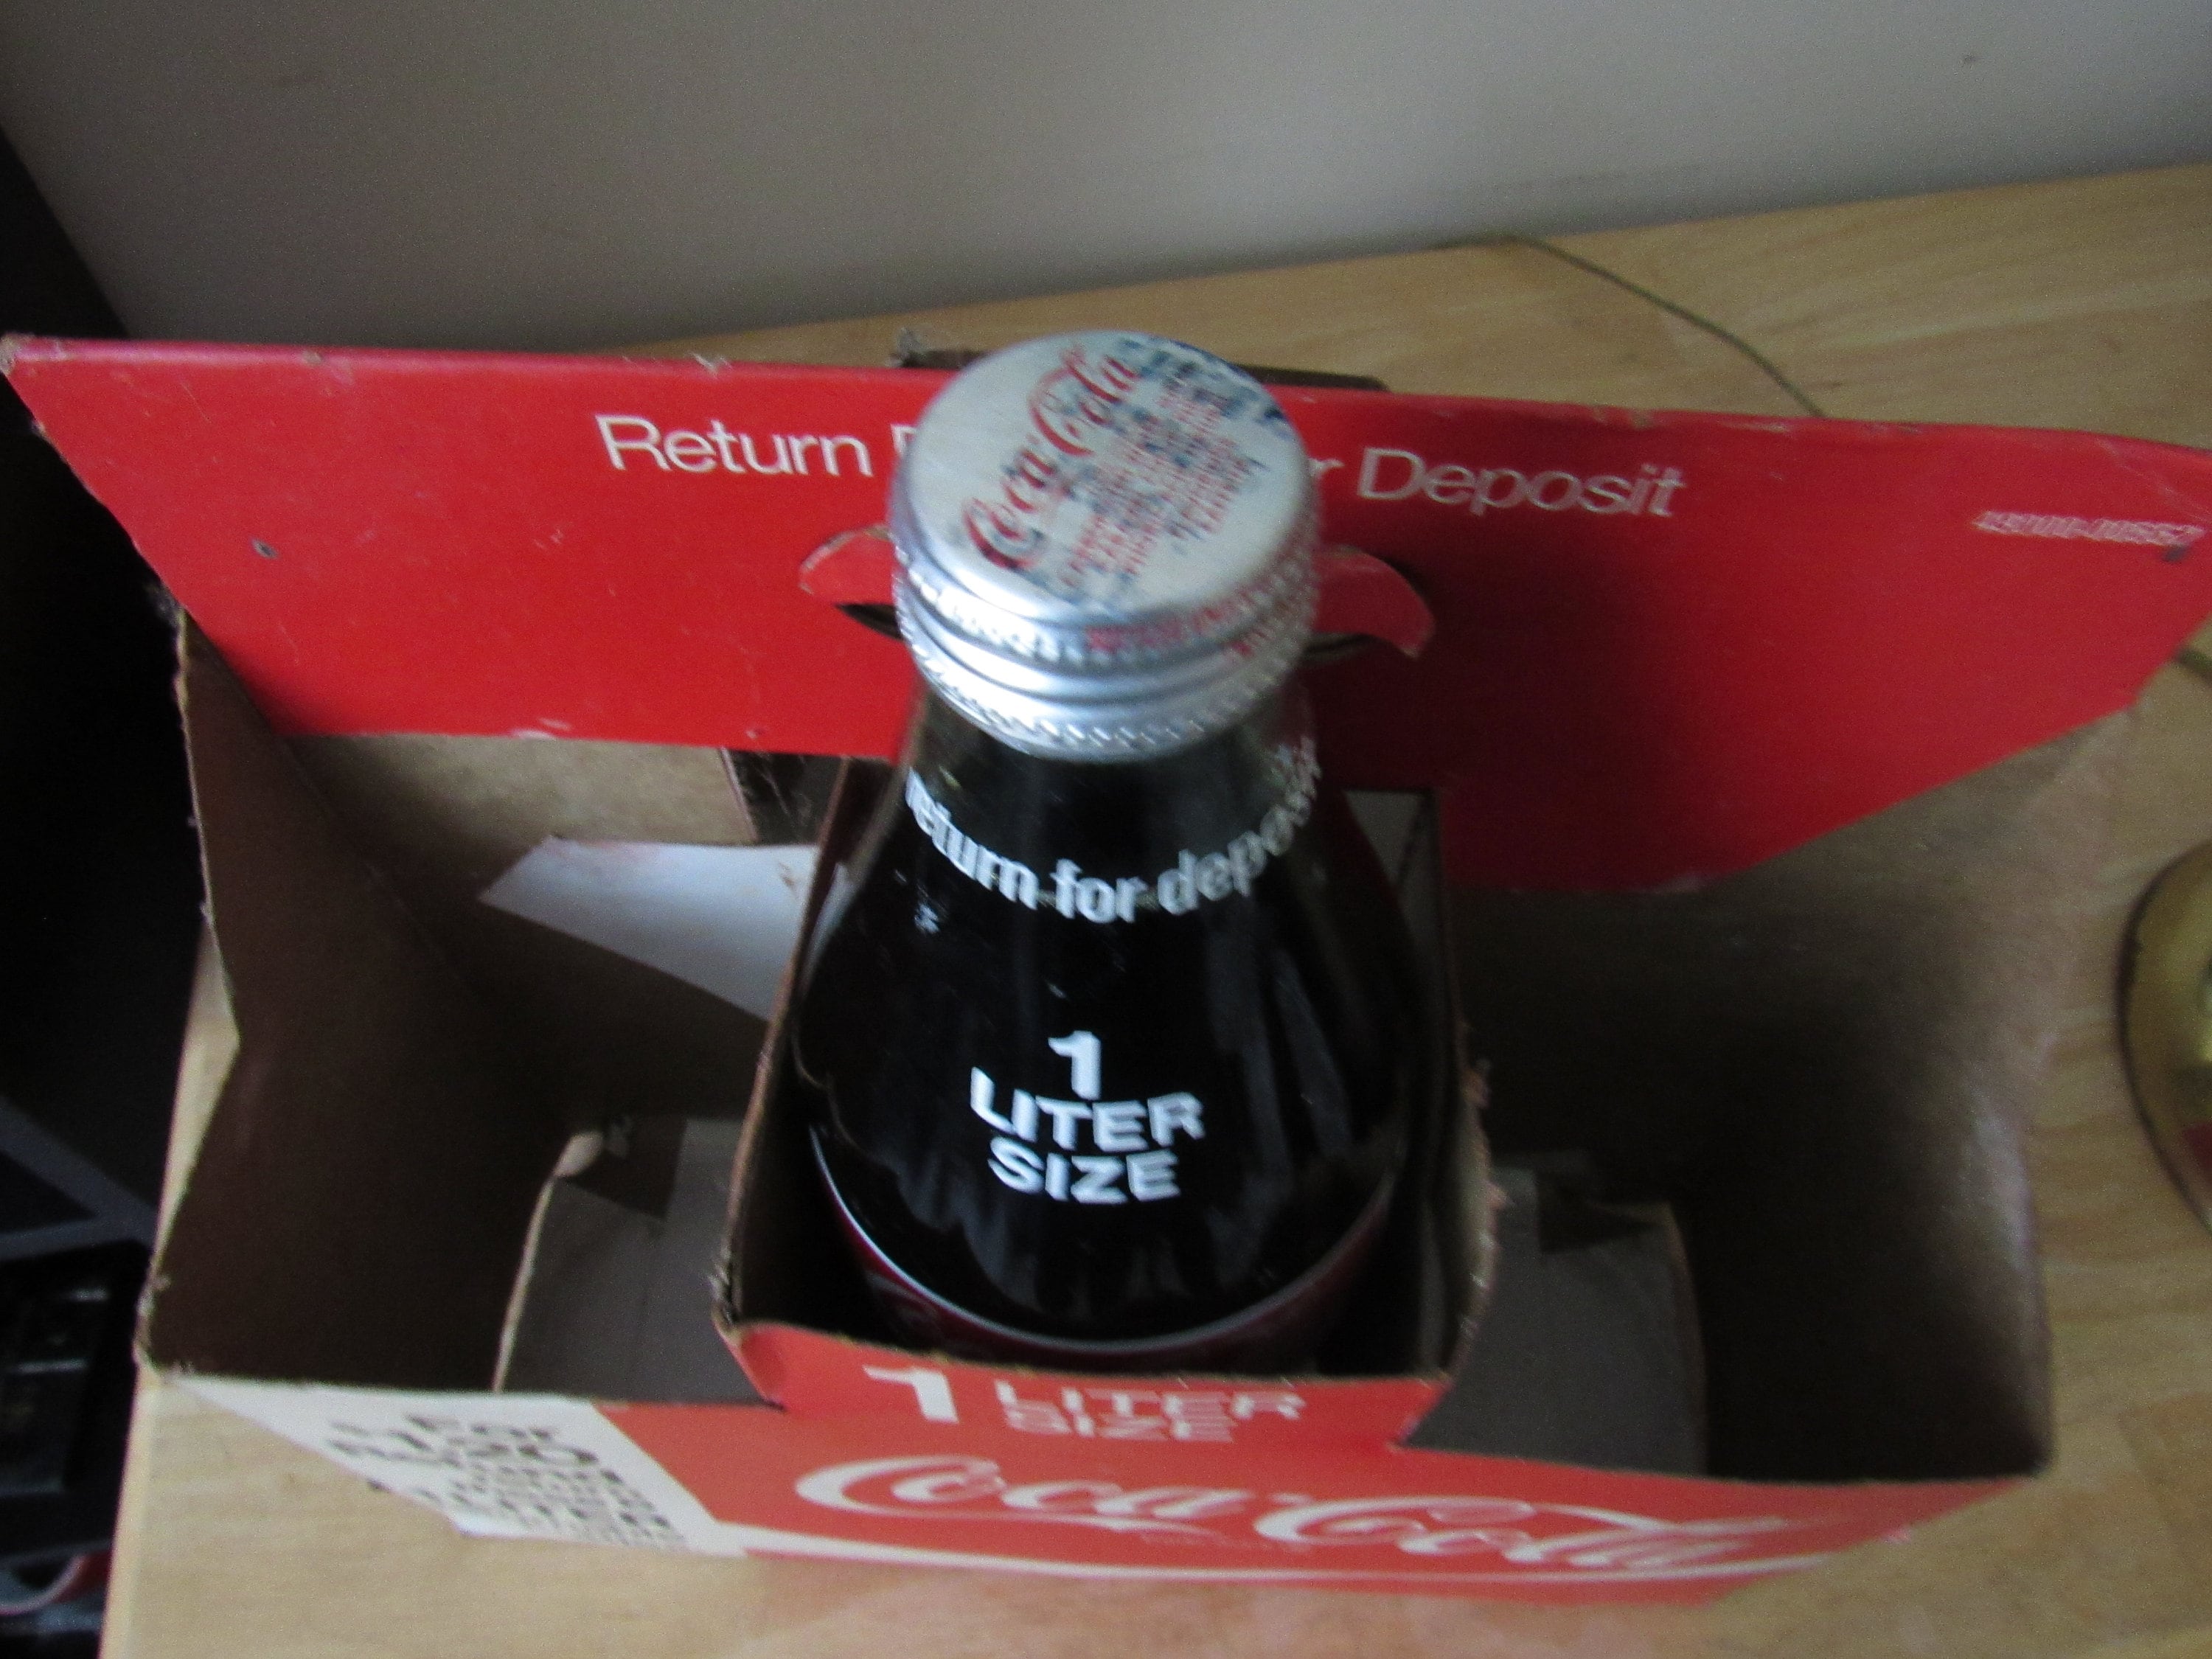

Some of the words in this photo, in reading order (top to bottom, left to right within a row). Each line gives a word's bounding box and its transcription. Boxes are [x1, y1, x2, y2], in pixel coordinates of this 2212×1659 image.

[594, 413, 874, 477] Return
[1357, 447, 1687, 517] Deposit
[1050, 858, 1149, 923] for
[1048, 1030, 1102, 1101] 1
[970, 1066, 1206, 1152] LITER
[987, 1135, 1180, 1205] SIZE
[864, 1364, 959, 1425] 1
